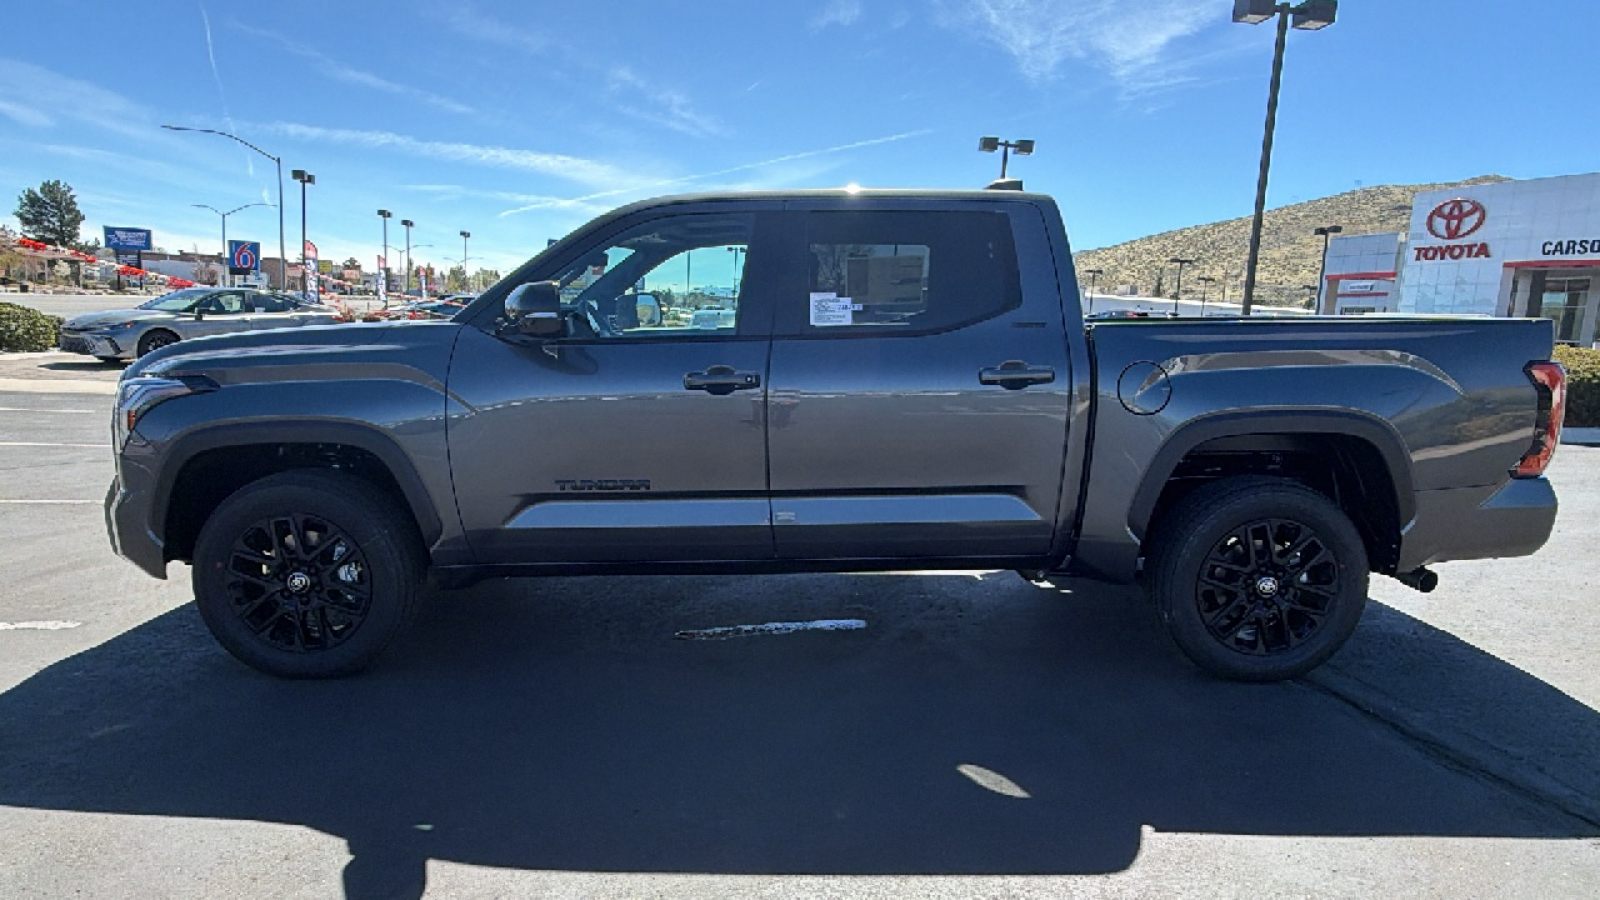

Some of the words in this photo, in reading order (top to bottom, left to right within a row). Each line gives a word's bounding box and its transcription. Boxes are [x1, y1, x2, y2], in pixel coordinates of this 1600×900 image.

[235, 242, 255, 269] 6
[1414, 243, 1490, 261] TOYOTA
[1542, 240, 1600, 255] CARSO
[555, 480, 650, 490] TUNDRA
